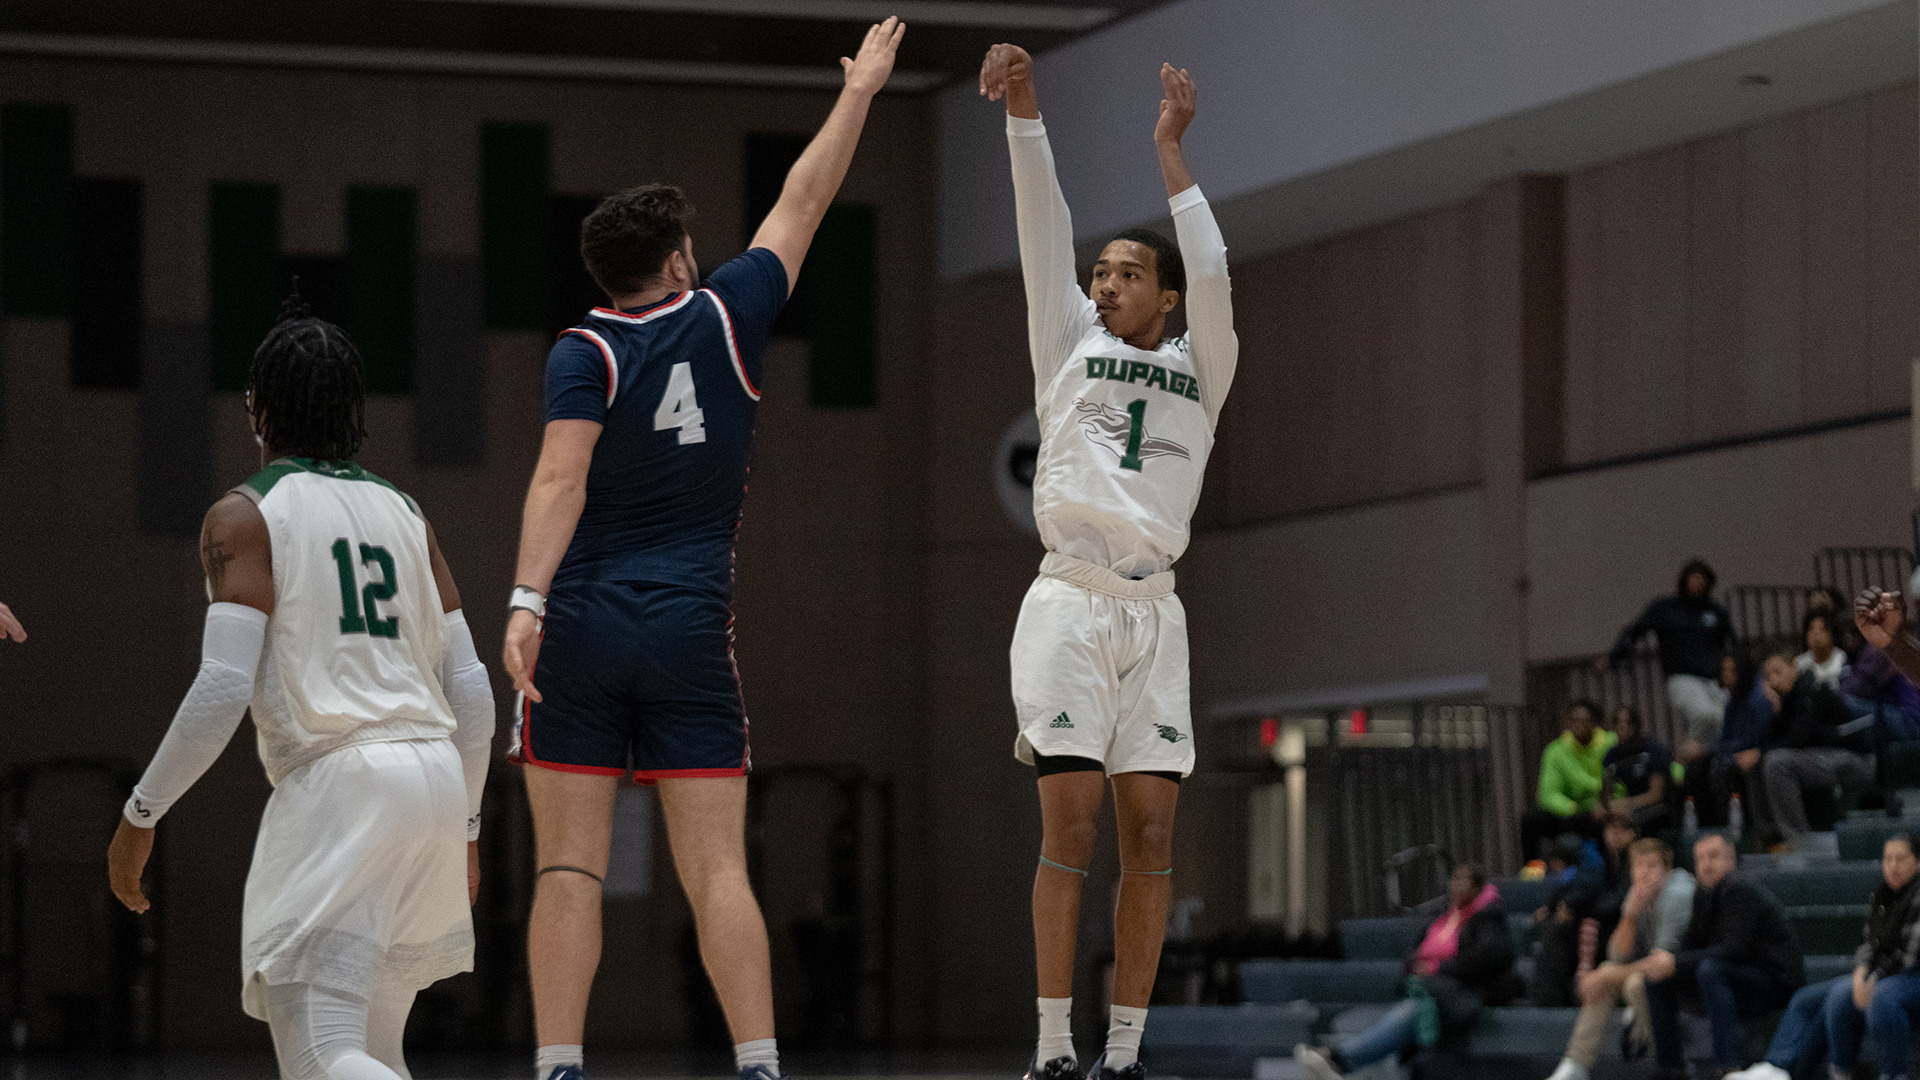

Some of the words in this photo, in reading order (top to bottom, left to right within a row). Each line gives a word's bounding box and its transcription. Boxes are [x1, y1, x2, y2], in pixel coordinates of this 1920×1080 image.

[654, 361, 706, 445] 4
[1084, 357, 1200, 403] DUPAGE
[1119, 398, 1148, 473] 1
[331, 537, 400, 639] 12
[1050, 721, 1075, 729] adidas
